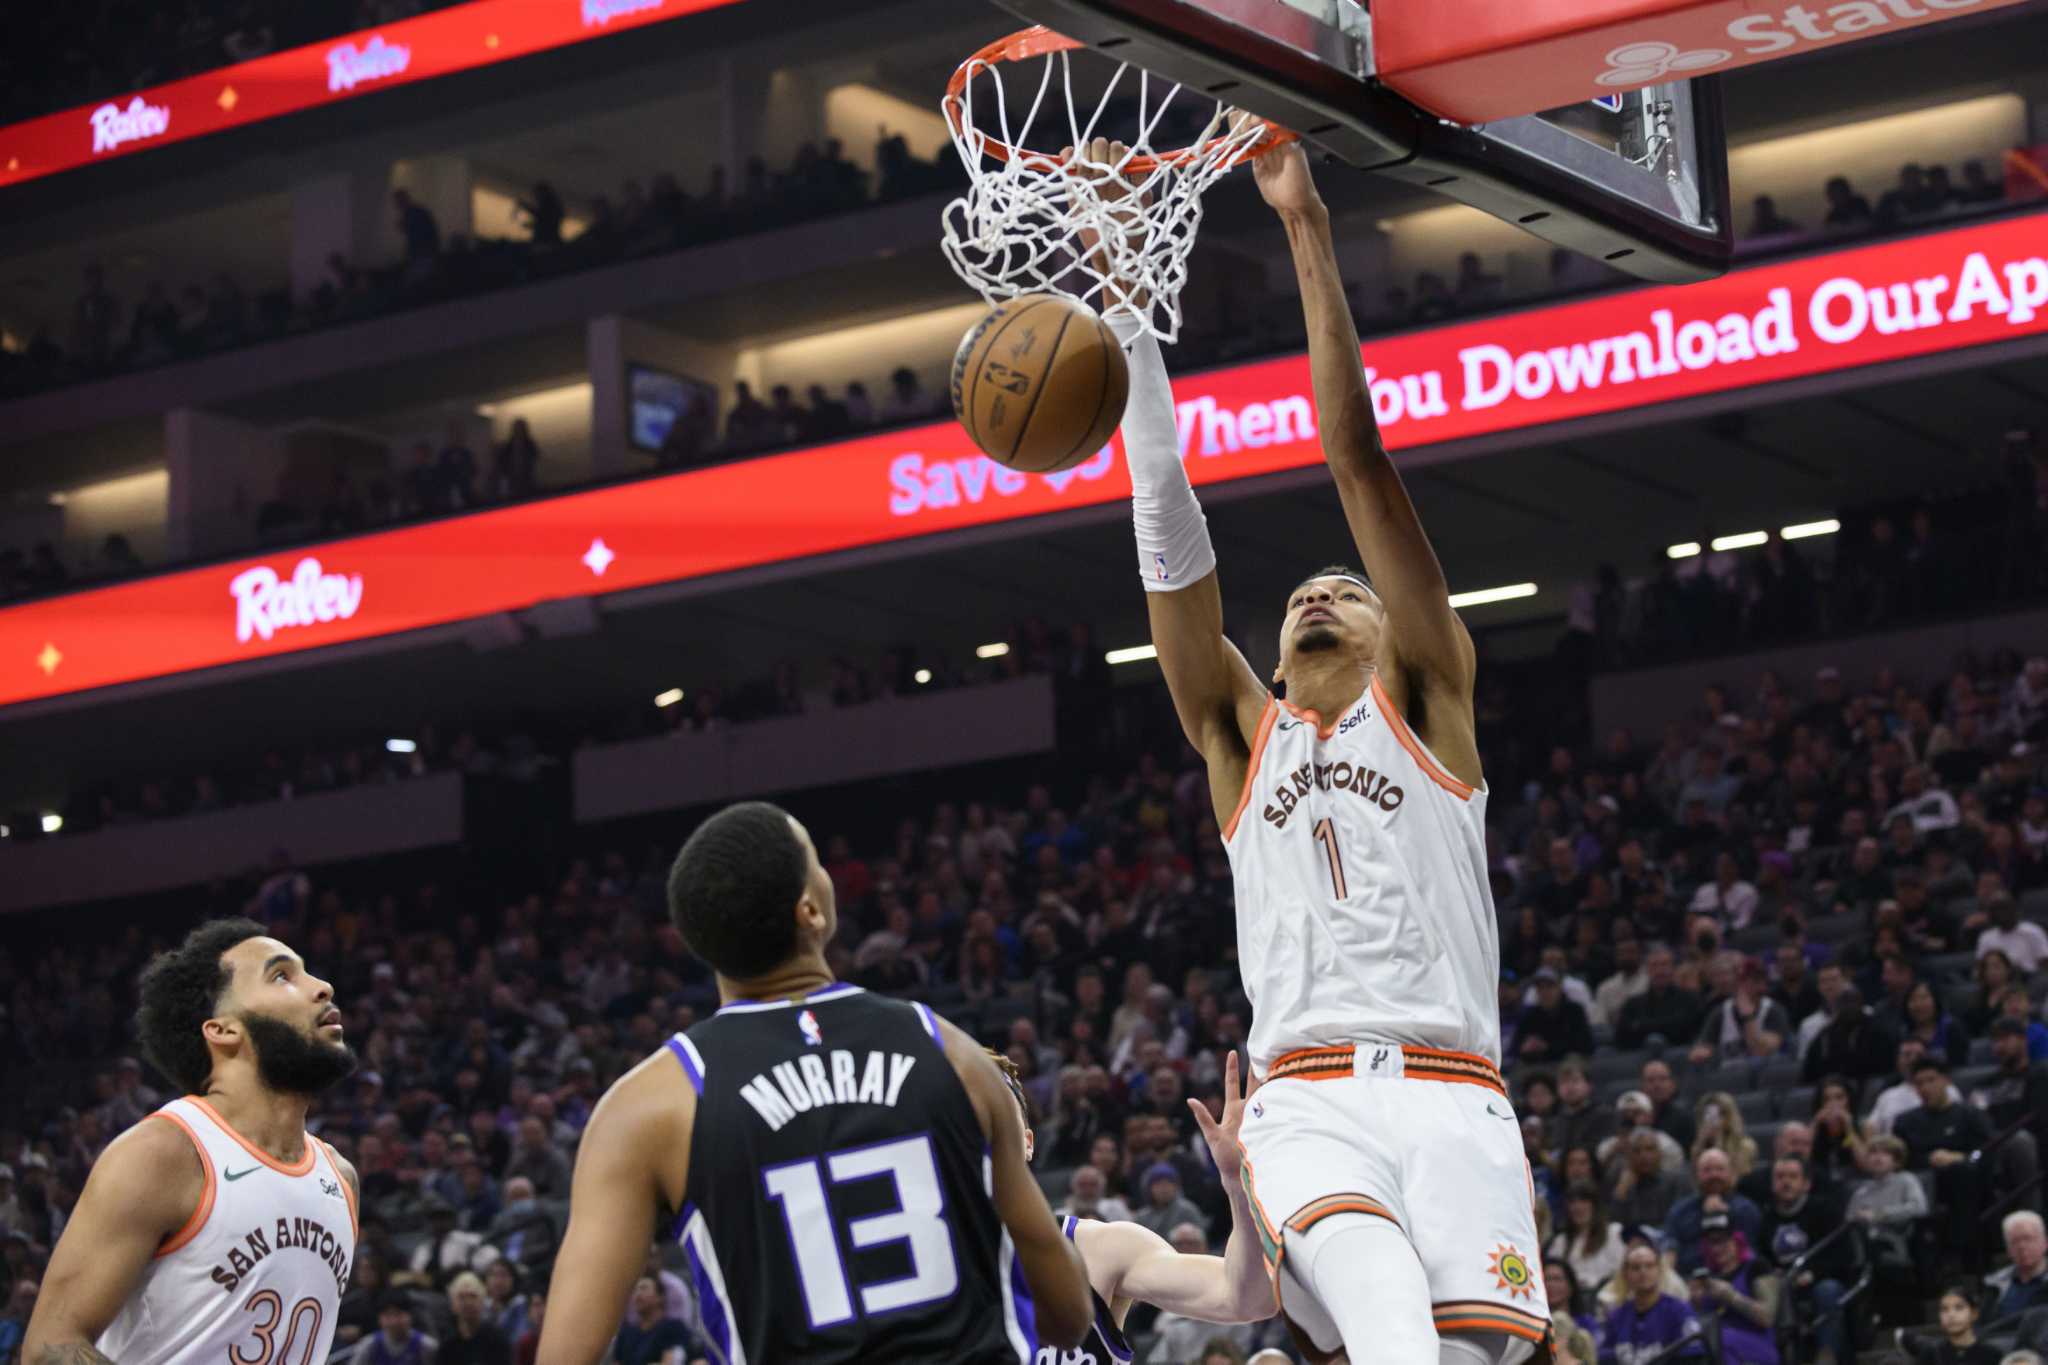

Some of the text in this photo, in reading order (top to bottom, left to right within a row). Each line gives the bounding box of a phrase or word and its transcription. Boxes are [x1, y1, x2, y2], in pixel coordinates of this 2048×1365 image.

[1364, 366, 1449, 426] ou
[1458, 287, 1799, 411] Download
[1808, 278, 1949, 344] Our
[1312, 817, 1348, 900] 1
[739, 1050, 916, 1132] MURRAY
[211, 1226, 271, 1293] SAN
[760, 1130, 960, 1332] 13
[229, 1289, 323, 1365] 30
